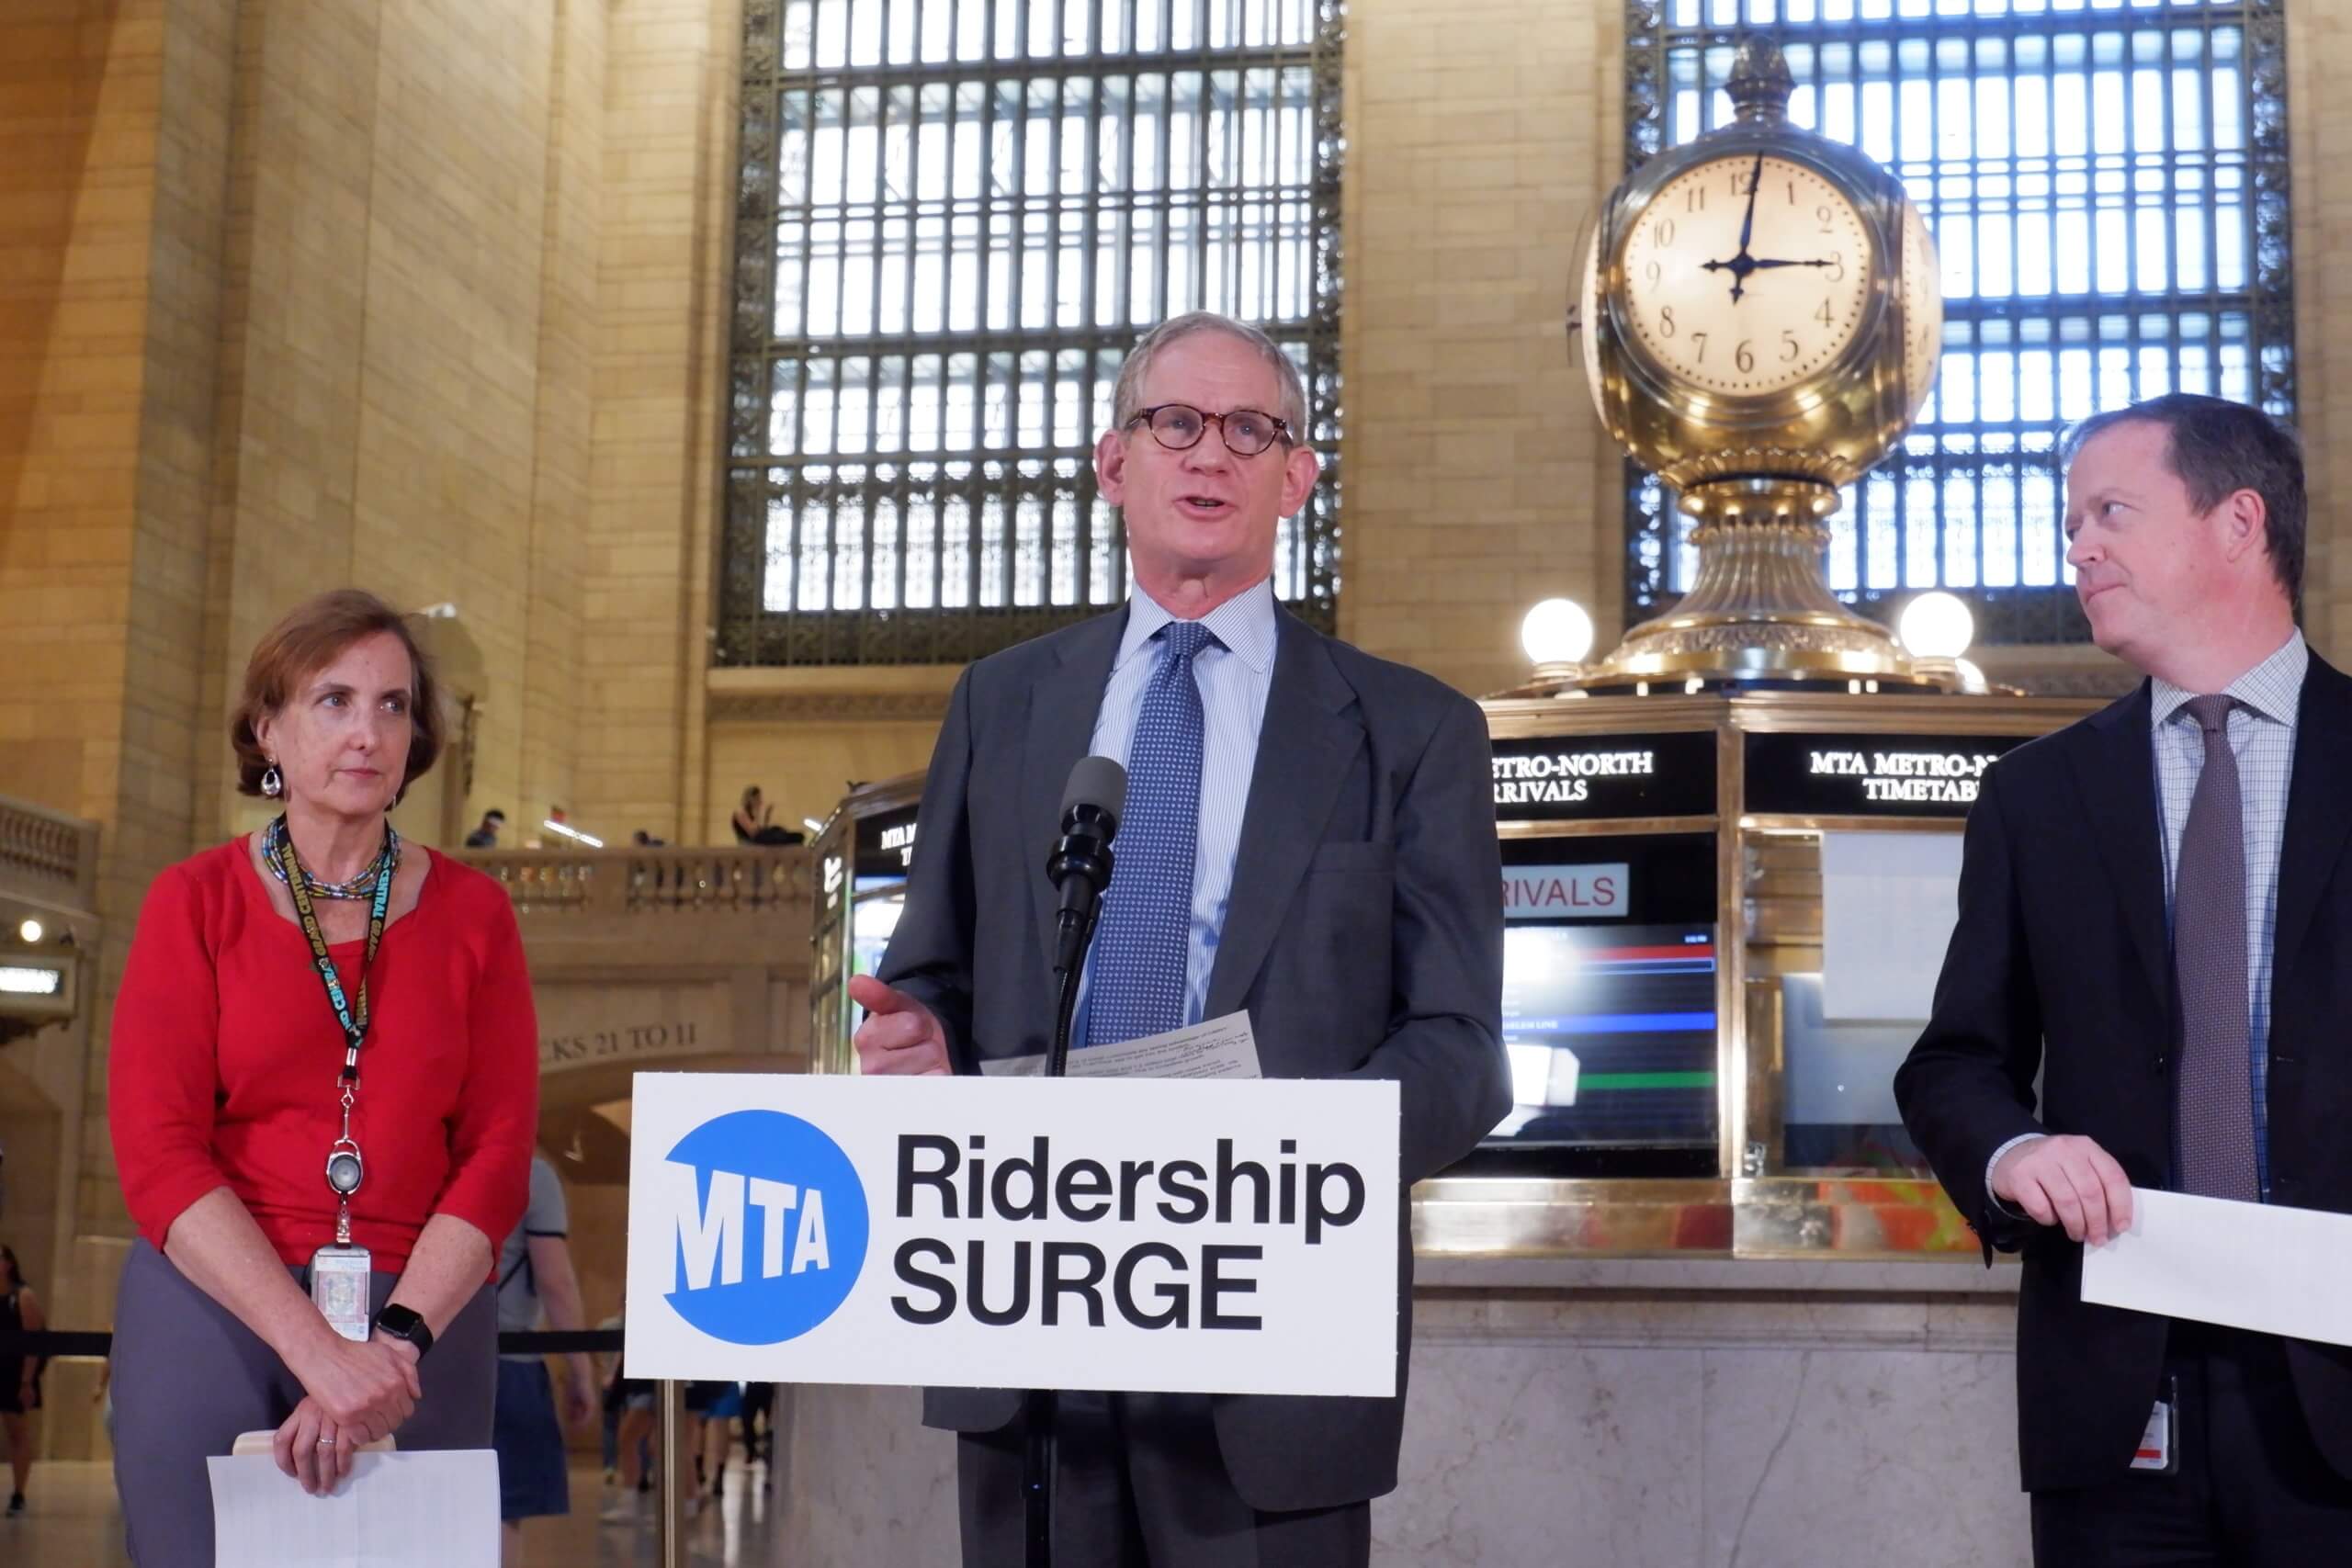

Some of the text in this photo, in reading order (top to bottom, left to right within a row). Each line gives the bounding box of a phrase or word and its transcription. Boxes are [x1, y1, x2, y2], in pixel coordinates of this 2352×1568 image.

[1687, 186, 1706, 213] 11
[1786, 181, 1795, 206] 1
[1654, 219, 1675, 247] 10
[1646, 258, 1661, 293] 9
[1825, 251, 1845, 283] 3
[1659, 305, 1676, 338] 8
[1815, 297, 1835, 328] 4
[1690, 332, 1708, 364] 7
[1736, 340, 1755, 374] 6
[1780, 330, 1799, 362] 5
[1492, 751, 1654, 778] ETRO-NORTH
[1810, 751, 1999, 777] MTA METRO-N
[1494, 780, 1589, 804] RRIVALS
[1862, 778, 1979, 802] TIMETAB
[372, 869, 390, 918] CENTRAL
[1501, 876, 1616, 908] RIVALS
[626, 1022, 669, 1049] TO
[896, 1134, 1365, 1245] Ridership
[666, 1160, 830, 1296] MTA
[890, 1237, 1263, 1331] SURGE
